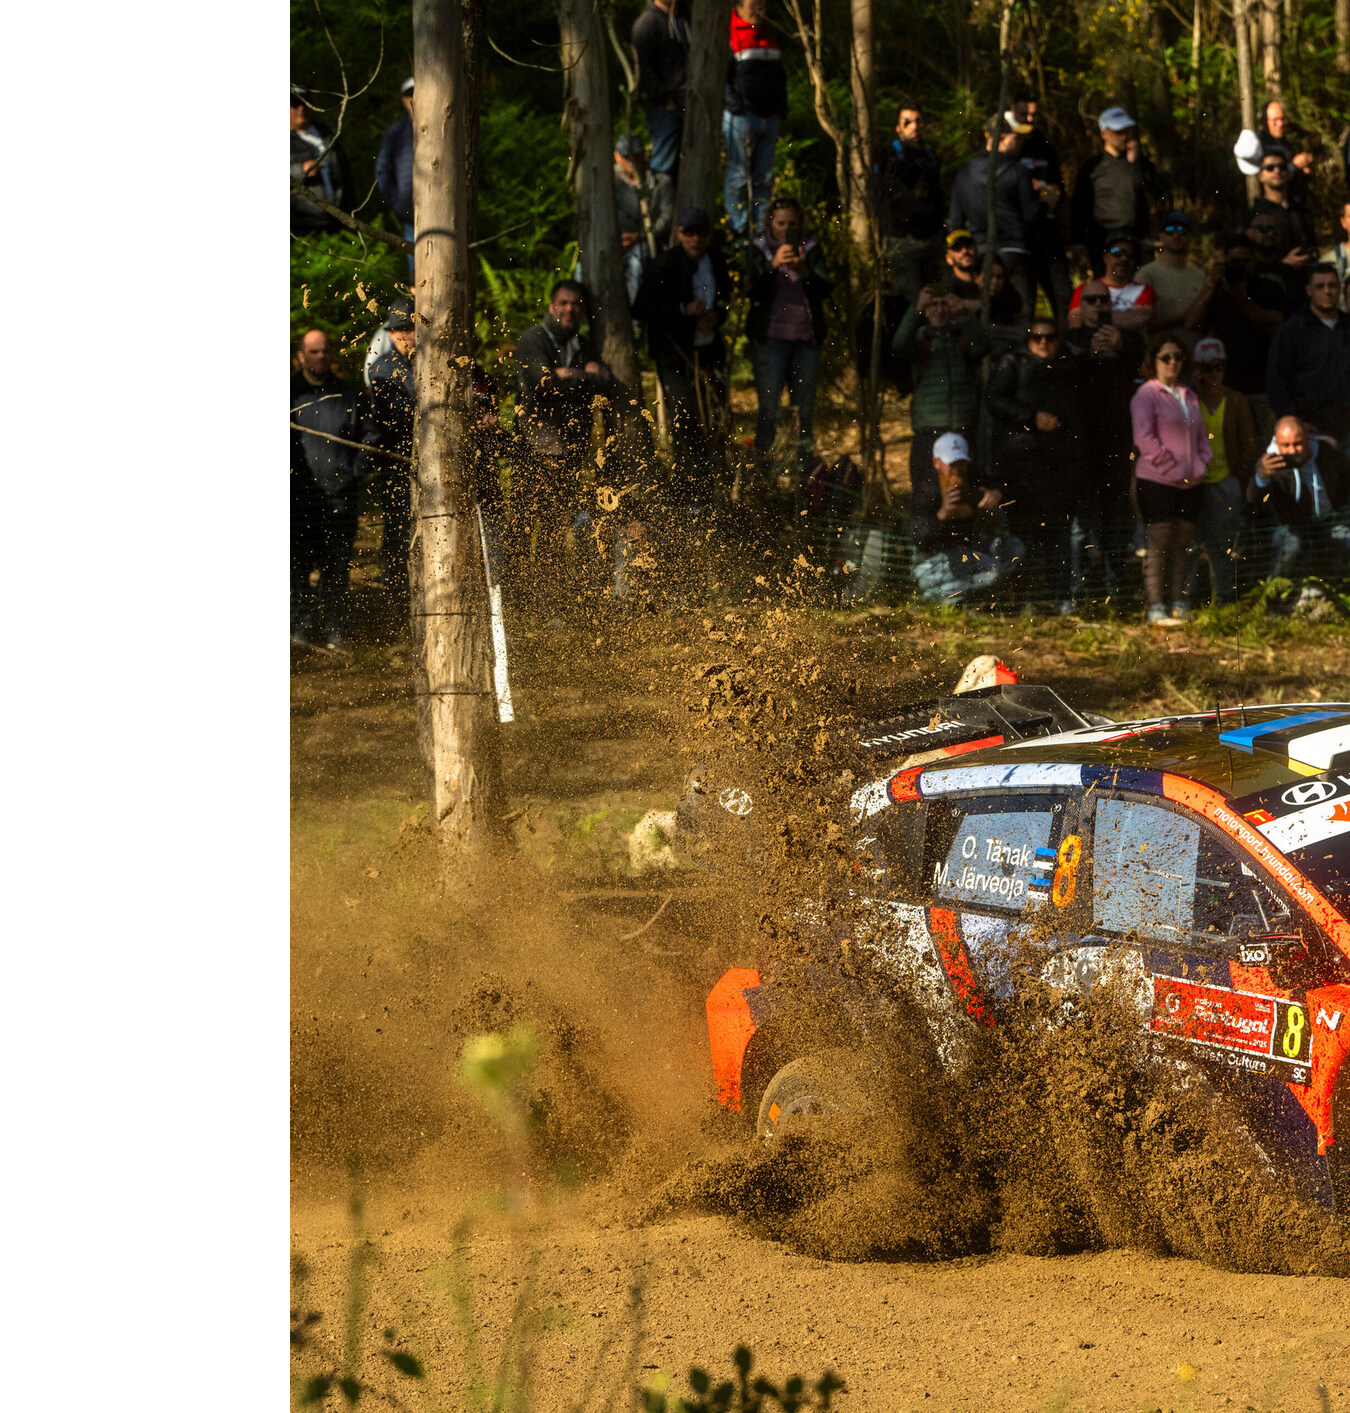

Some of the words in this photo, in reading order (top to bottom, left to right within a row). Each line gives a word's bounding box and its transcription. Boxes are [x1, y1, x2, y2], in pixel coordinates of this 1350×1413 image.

[962, 835, 978, 860] O.
[985, 838, 1032, 867] Tänak
[1052, 834, 1082, 907] 8
[1213, 807, 1315, 905] motorsport.hyundai.com
[933, 861, 951, 887] M.
[956, 866, 1024, 901] Järveoja
[1283, 1006, 1305, 1058] 8
[1293, 1067, 1307, 1080] SC
